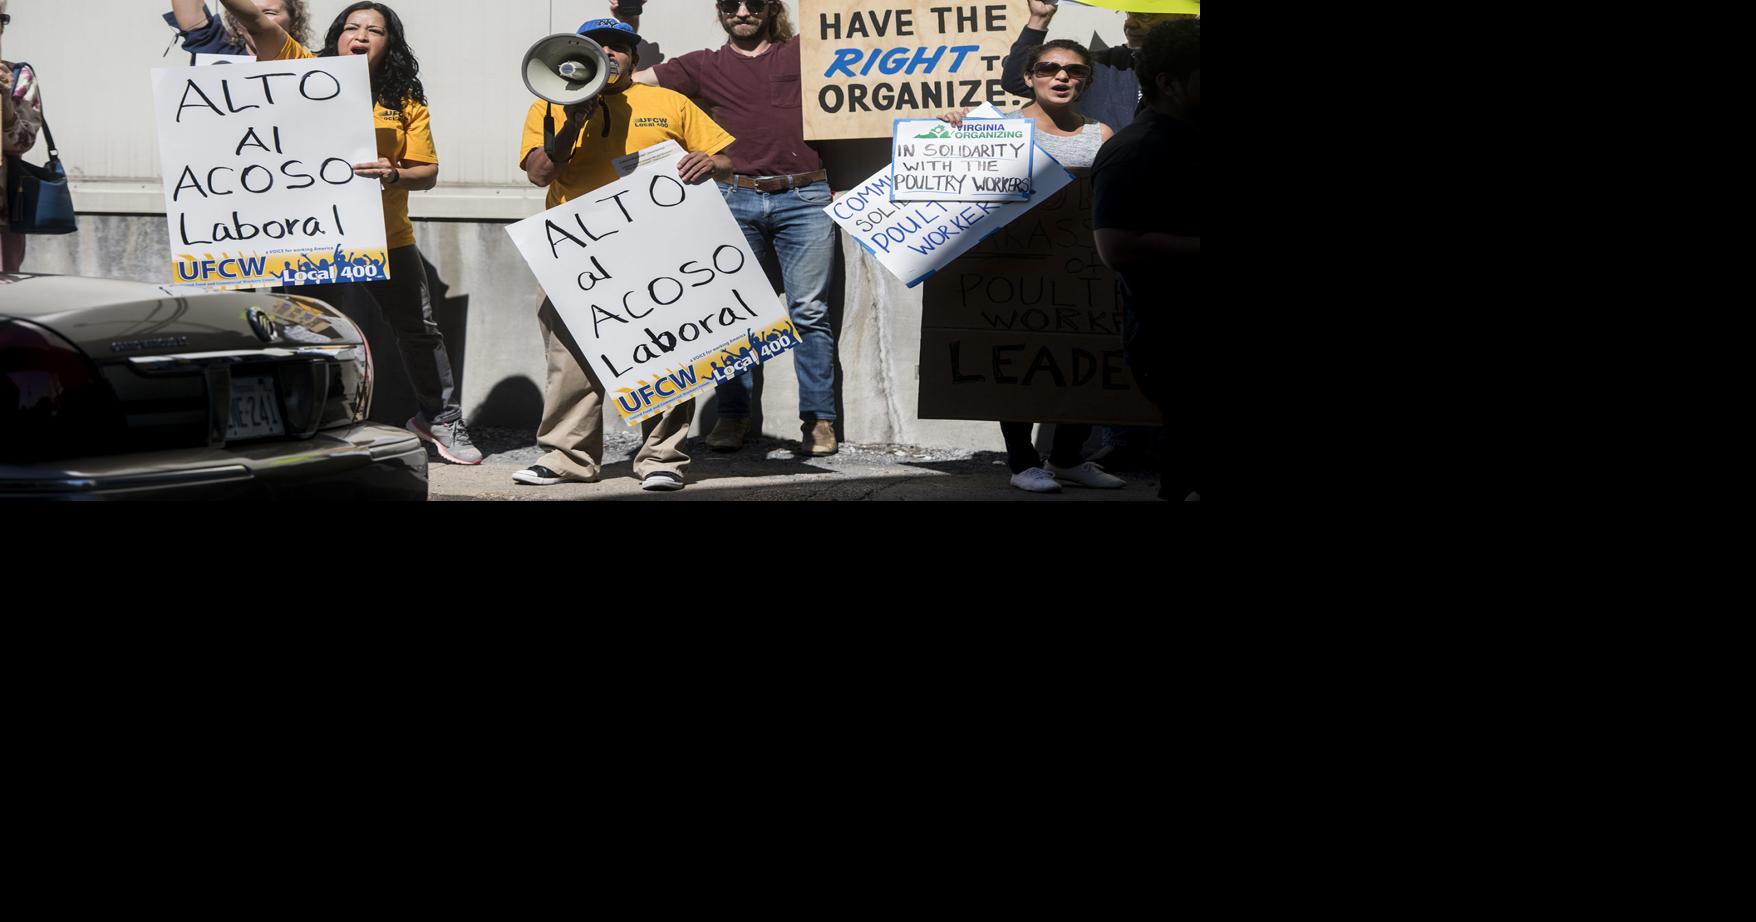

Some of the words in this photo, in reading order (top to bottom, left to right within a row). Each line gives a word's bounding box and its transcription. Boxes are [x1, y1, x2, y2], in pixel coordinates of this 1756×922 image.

[820, 9, 914, 40] HAVE
[930, 5, 1007, 34] THE
[823, 45, 980, 78] RIGHT
[980, 55, 1005, 71] T
[176, 69, 341, 122] ALTO
[955, 131, 1023, 139] ORGANIZING
[956, 123, 1005, 131] VIRGINIA
[897, 144, 915, 157] IN
[923, 143, 1025, 158] SOLIDARITY
[903, 161, 952, 172] WITH
[963, 160, 999, 172] THE
[173, 157, 354, 202] ACOSO
[834, 175, 891, 219] COMM
[894, 174, 967, 194] POULTRY
[180, 204, 345, 246] Laboral
[545, 175, 686, 259] ALTO
[871, 200, 948, 253] POULT
[907, 200, 1003, 255] WORKER
[178, 255, 267, 281] UFCW
[283, 265, 335, 282] Local
[341, 264, 377, 279] 400
[590, 244, 744, 339] ACOSO
[961, 273, 1123, 307] POULT
[601, 289, 758, 378] Laboral
[713, 349, 758, 382] Local
[760, 335, 792, 357] 400
[949, 340, 1132, 391] LEADE
[618, 364, 698, 413] UFCW
